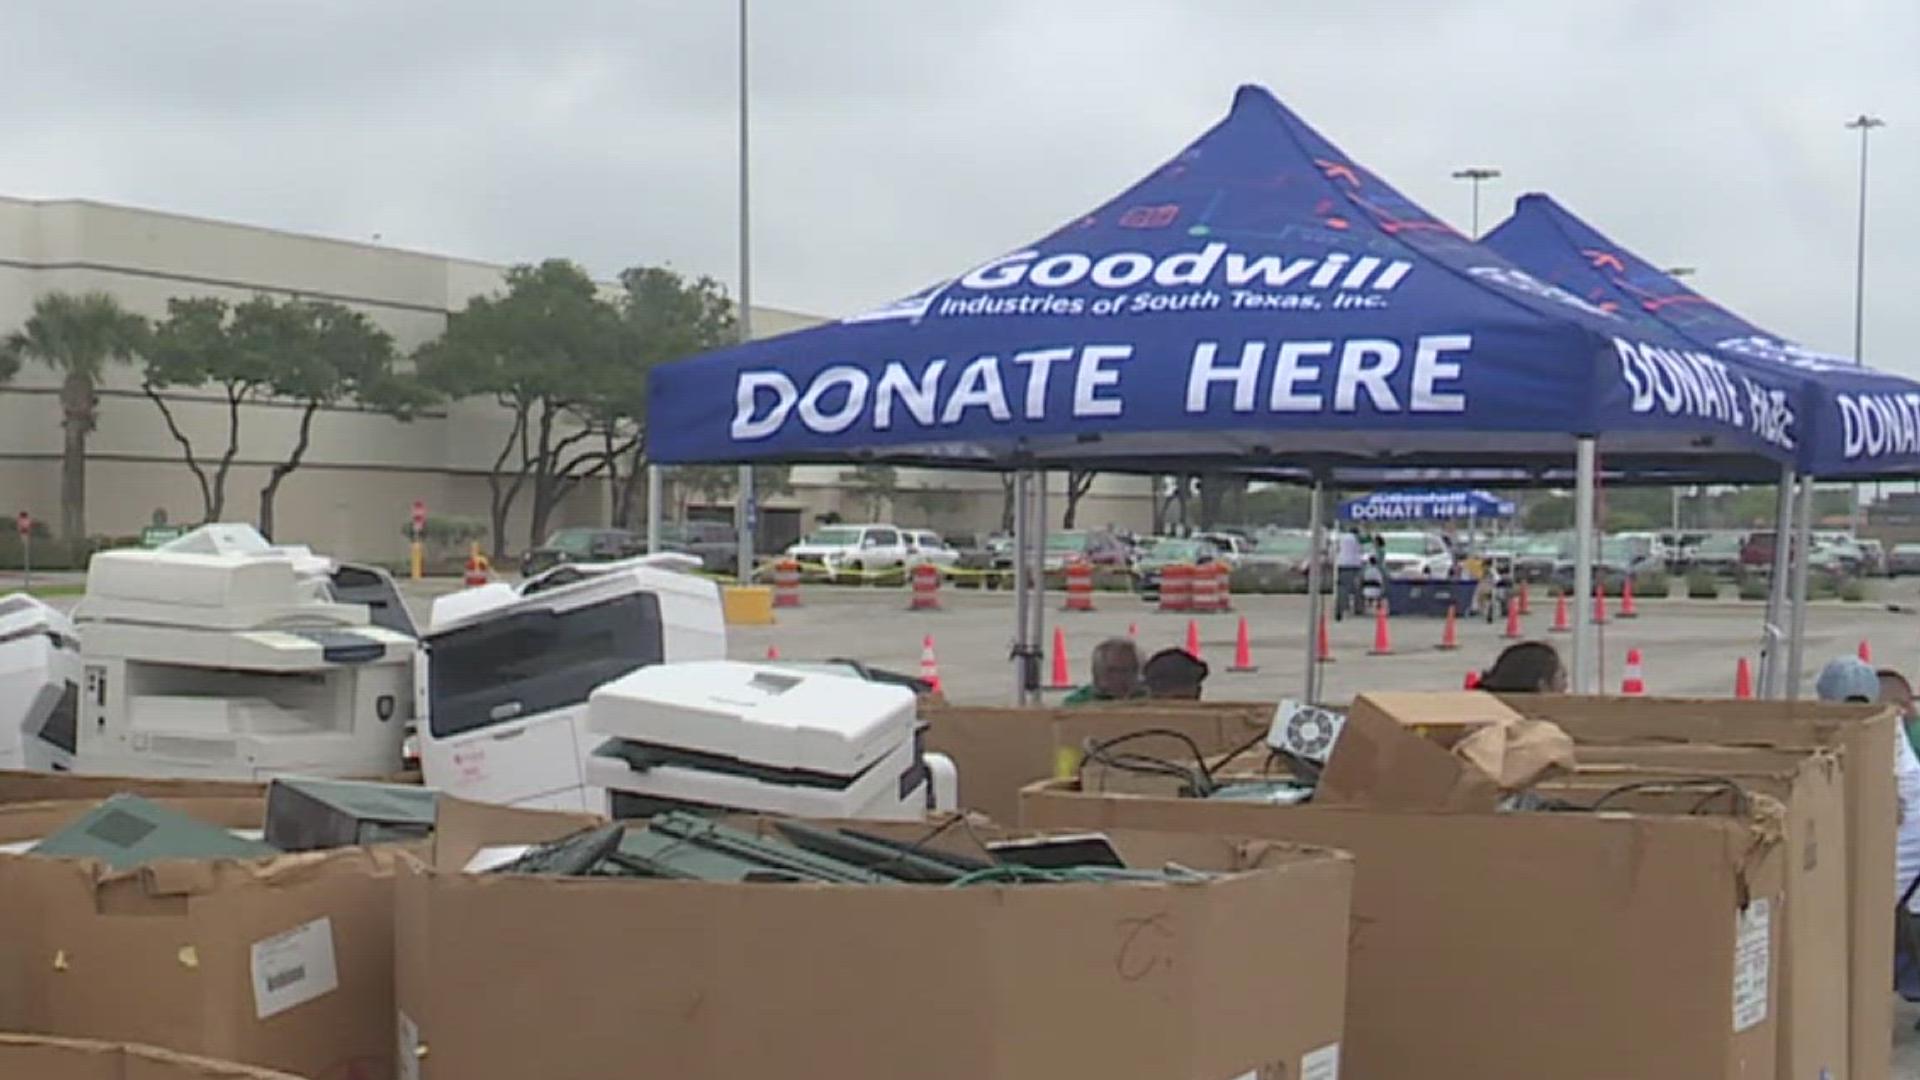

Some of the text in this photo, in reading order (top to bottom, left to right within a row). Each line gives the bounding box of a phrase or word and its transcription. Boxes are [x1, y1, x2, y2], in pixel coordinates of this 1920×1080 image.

[961, 242, 1412, 289] Goodwill
[939, 290, 1388, 315] Industries of South Texas, Inc.
[731, 334, 1472, 440] DONATE HERE
[1612, 335, 1744, 427] DONATE
[1352, 502, 1478, 519] DONATE HERE
